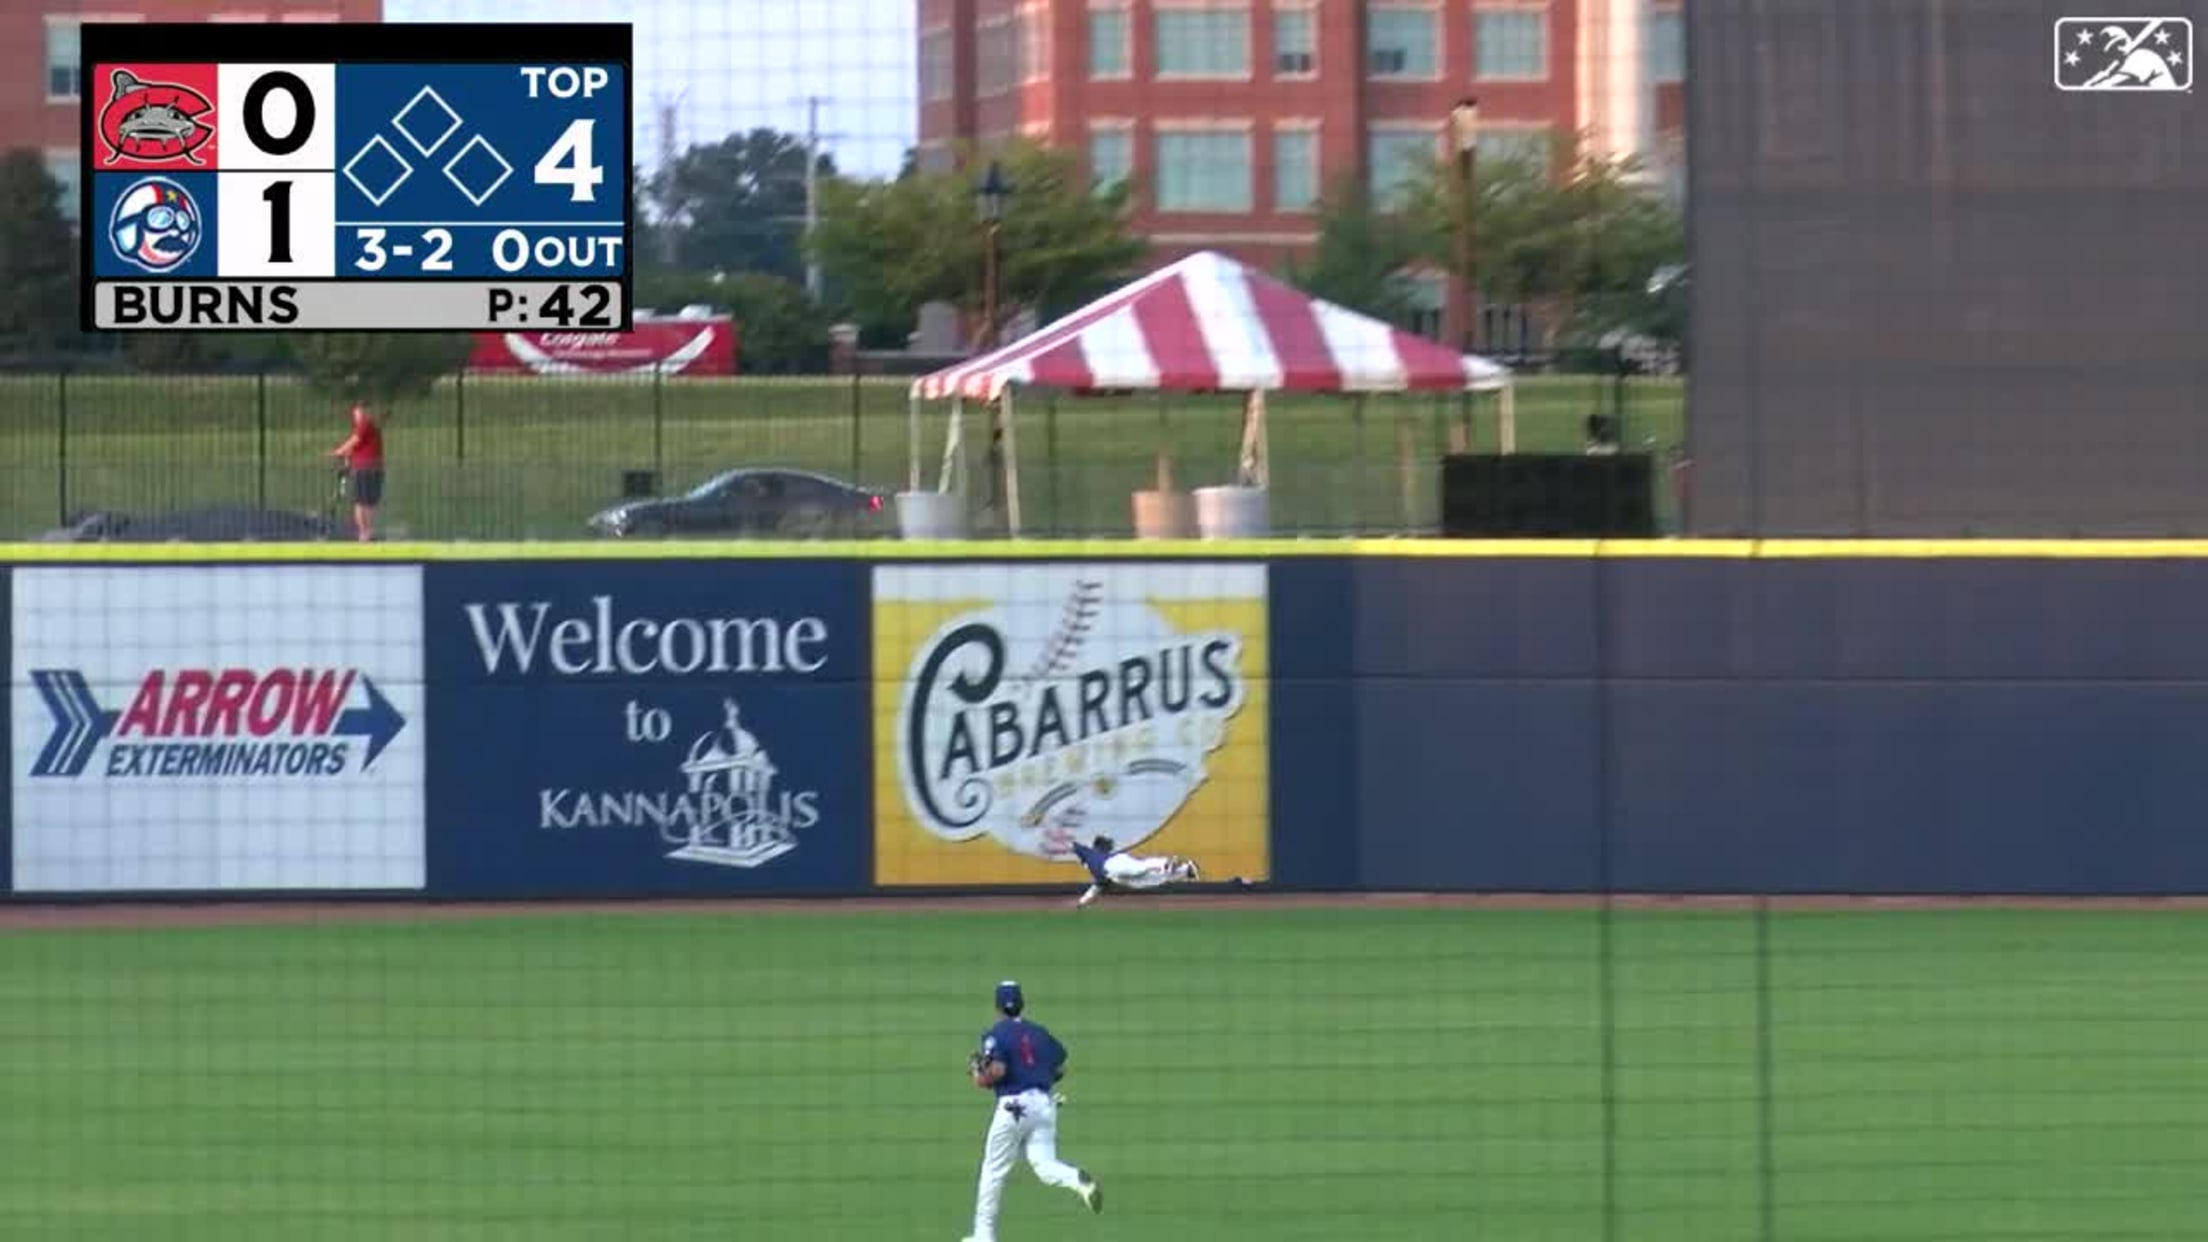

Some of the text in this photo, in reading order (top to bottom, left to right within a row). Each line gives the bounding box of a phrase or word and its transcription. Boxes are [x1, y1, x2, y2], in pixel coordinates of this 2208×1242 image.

[465, 595, 828, 675] Welcome
[116, 668, 358, 738] ARROW
[625, 700, 672, 742] to
[910, 623, 1233, 829] CABARRUS
[105, 742, 349, 778] EXTERMINATORS
[538, 787, 821, 830] KANNAPOLIS
